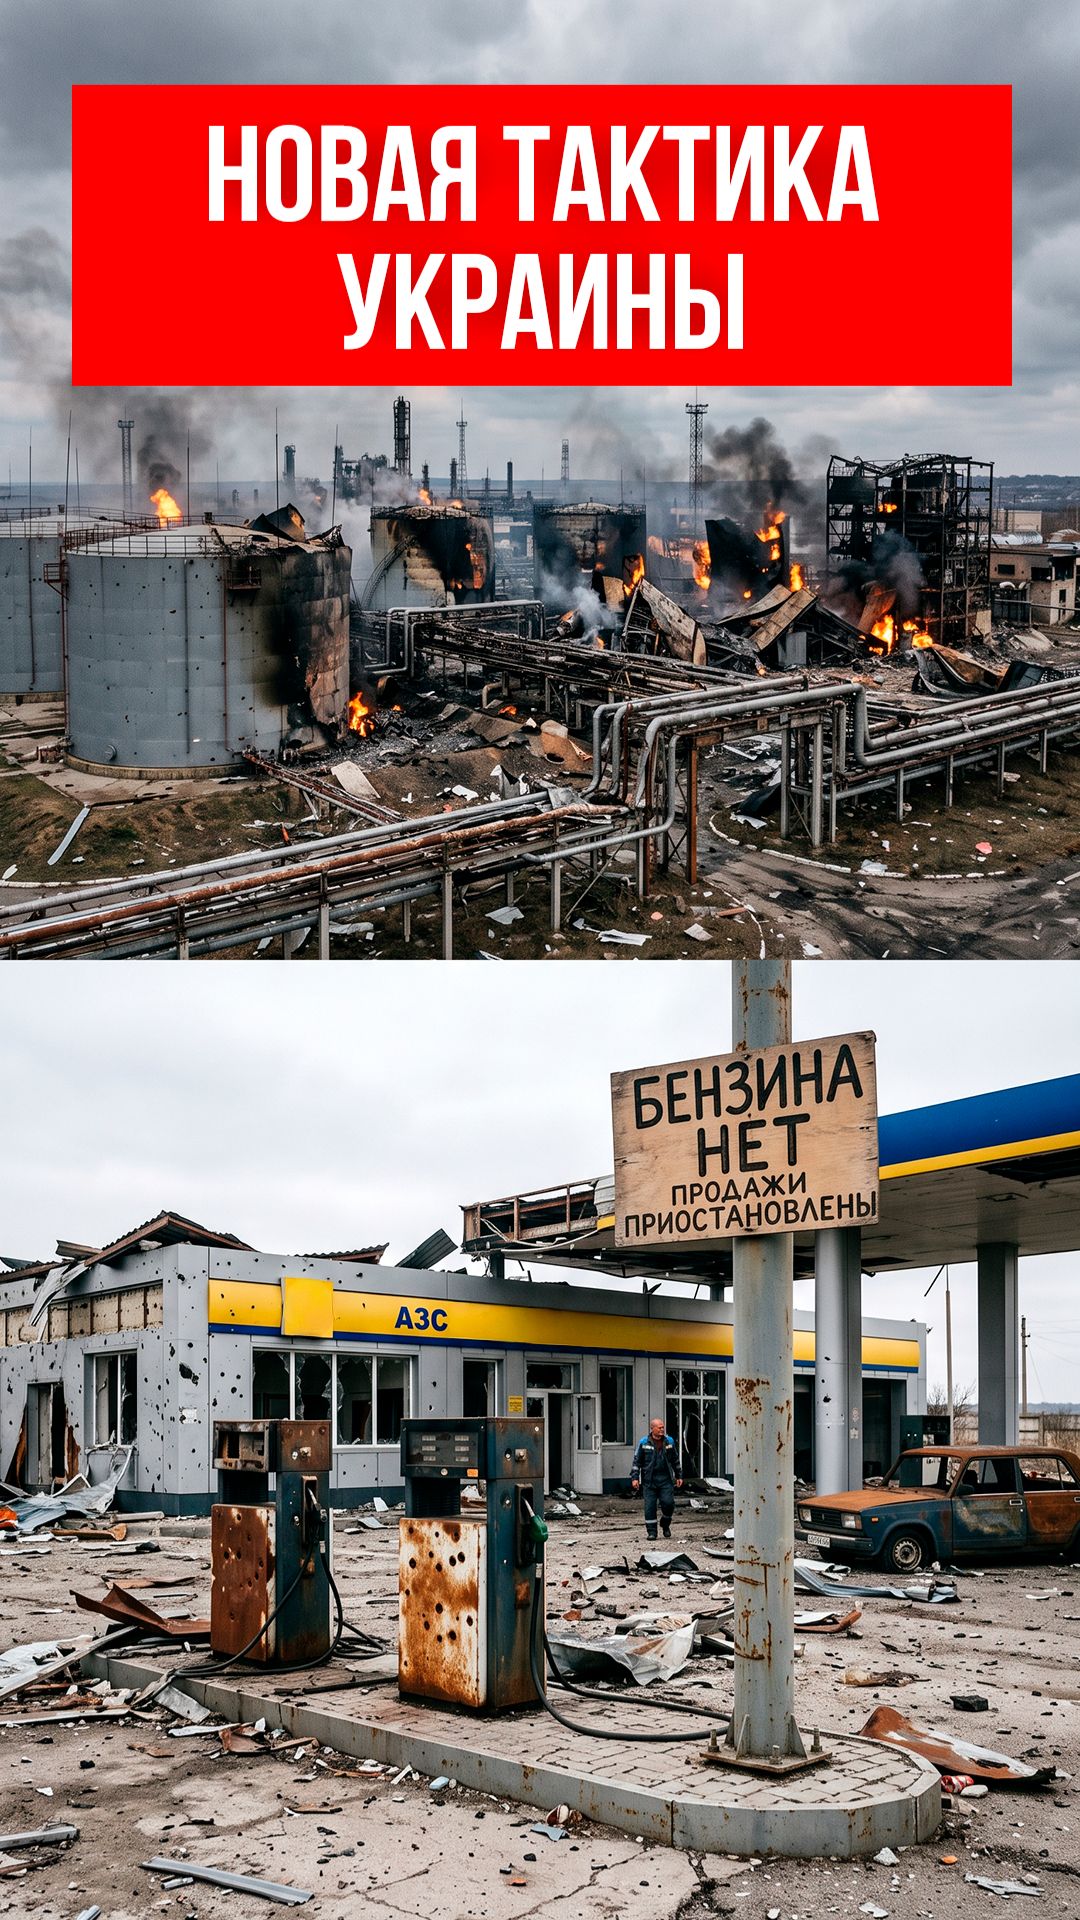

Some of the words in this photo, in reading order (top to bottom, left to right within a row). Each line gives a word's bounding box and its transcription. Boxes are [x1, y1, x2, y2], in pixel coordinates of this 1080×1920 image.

[633, 1043, 864, 1130] БЕНЗИНА
[697, 1112, 811, 1178] НЕТ
[671, 1171, 807, 1206] ПРОДАЖИ
[624, 1190, 877, 1238] ПРИОСТАНОВЛЕНЫ
[394, 1305, 448, 1332] АЗС
